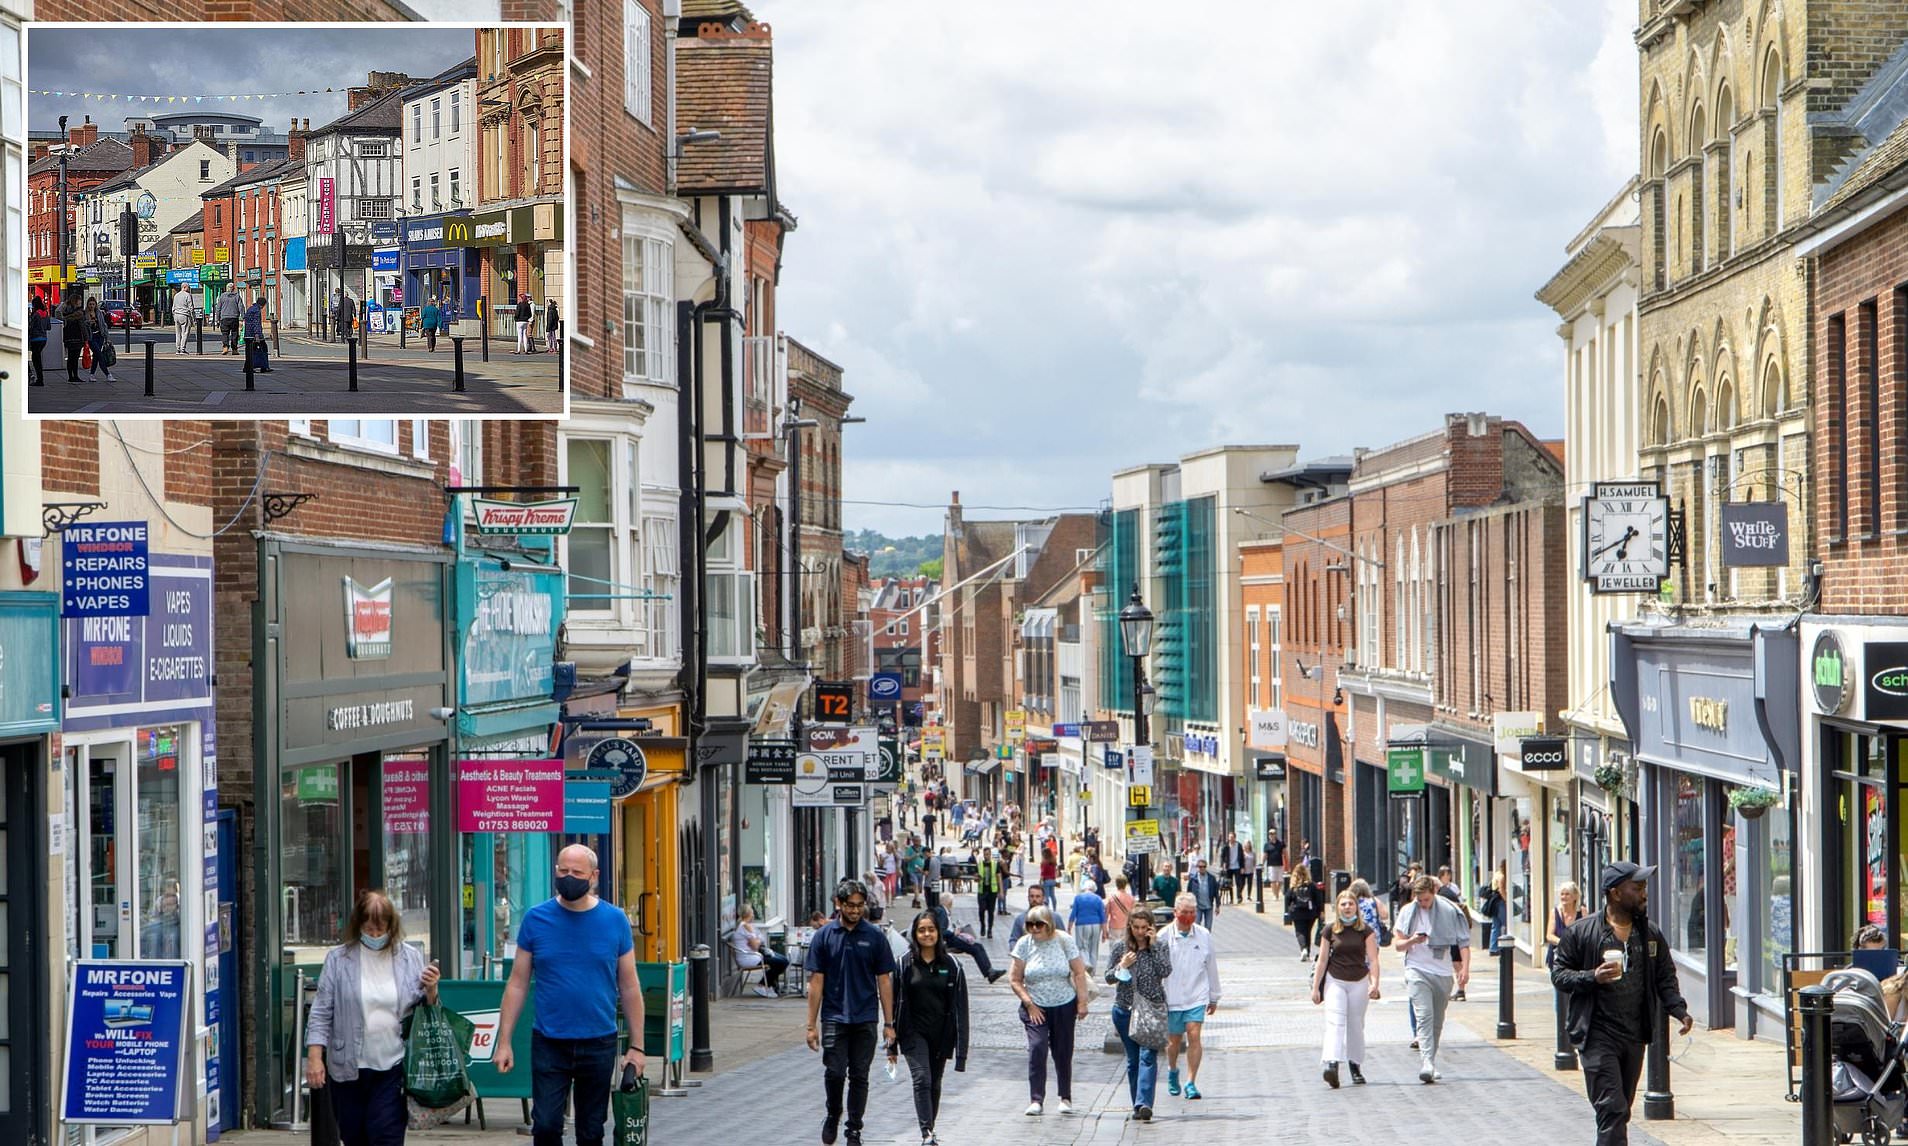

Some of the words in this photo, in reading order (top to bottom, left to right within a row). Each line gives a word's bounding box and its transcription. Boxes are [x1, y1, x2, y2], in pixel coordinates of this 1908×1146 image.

[482, 508, 526, 526] Krispy
[524, 508, 568, 526] Kreme
[77, 542, 134, 552] WINDSOR
[76, 556, 146, 572] REPAIRS
[76, 576, 144, 590] PHONES
[1601, 578, 1655, 588] JEWELLER
[76, 594, 130, 610] VAPES
[166, 590, 190, 614] VAPES
[163, 624, 192, 648] LIQUIDS
[357, 643, 391, 655] DOUGHNUTS
[150, 656, 204, 680] E-CIGARETTES
[820, 694, 848, 714] T2
[332, 706, 360, 730] COFFEE
[370, 699, 412, 725] DOUGHNUTS
[1258, 722, 1280, 730] M&S
[622, 743, 642, 766] YARD
[824, 755, 854, 764] RENT
[1524, 752, 1562, 763] ecco
[460, 770, 492, 781] Aesthetic
[493, 770, 499, 781] &
[500, 770, 523, 784] Beauty
[524, 770, 562, 781] Treatments
[840, 770, 855, 778] Unit
[486, 794, 509, 802] Lycon
[510, 794, 538, 802] Waxing
[1133, 786, 1146, 803] H
[472, 810, 514, 818] Weightloss
[516, 810, 552, 818] Treatment
[478, 820, 510, 830] 01753
[512, 820, 548, 830] 869020
[82, 990, 108, 998] Repairs
[114, 990, 156, 998] Accessories
[160, 991, 177, 999] Vape
[106, 1030, 136, 1040] WILL
[136, 1031, 152, 1040] FIX
[86, 1040, 114, 1048] YOUR
[122, 1048, 157, 1056] LAPTOP
